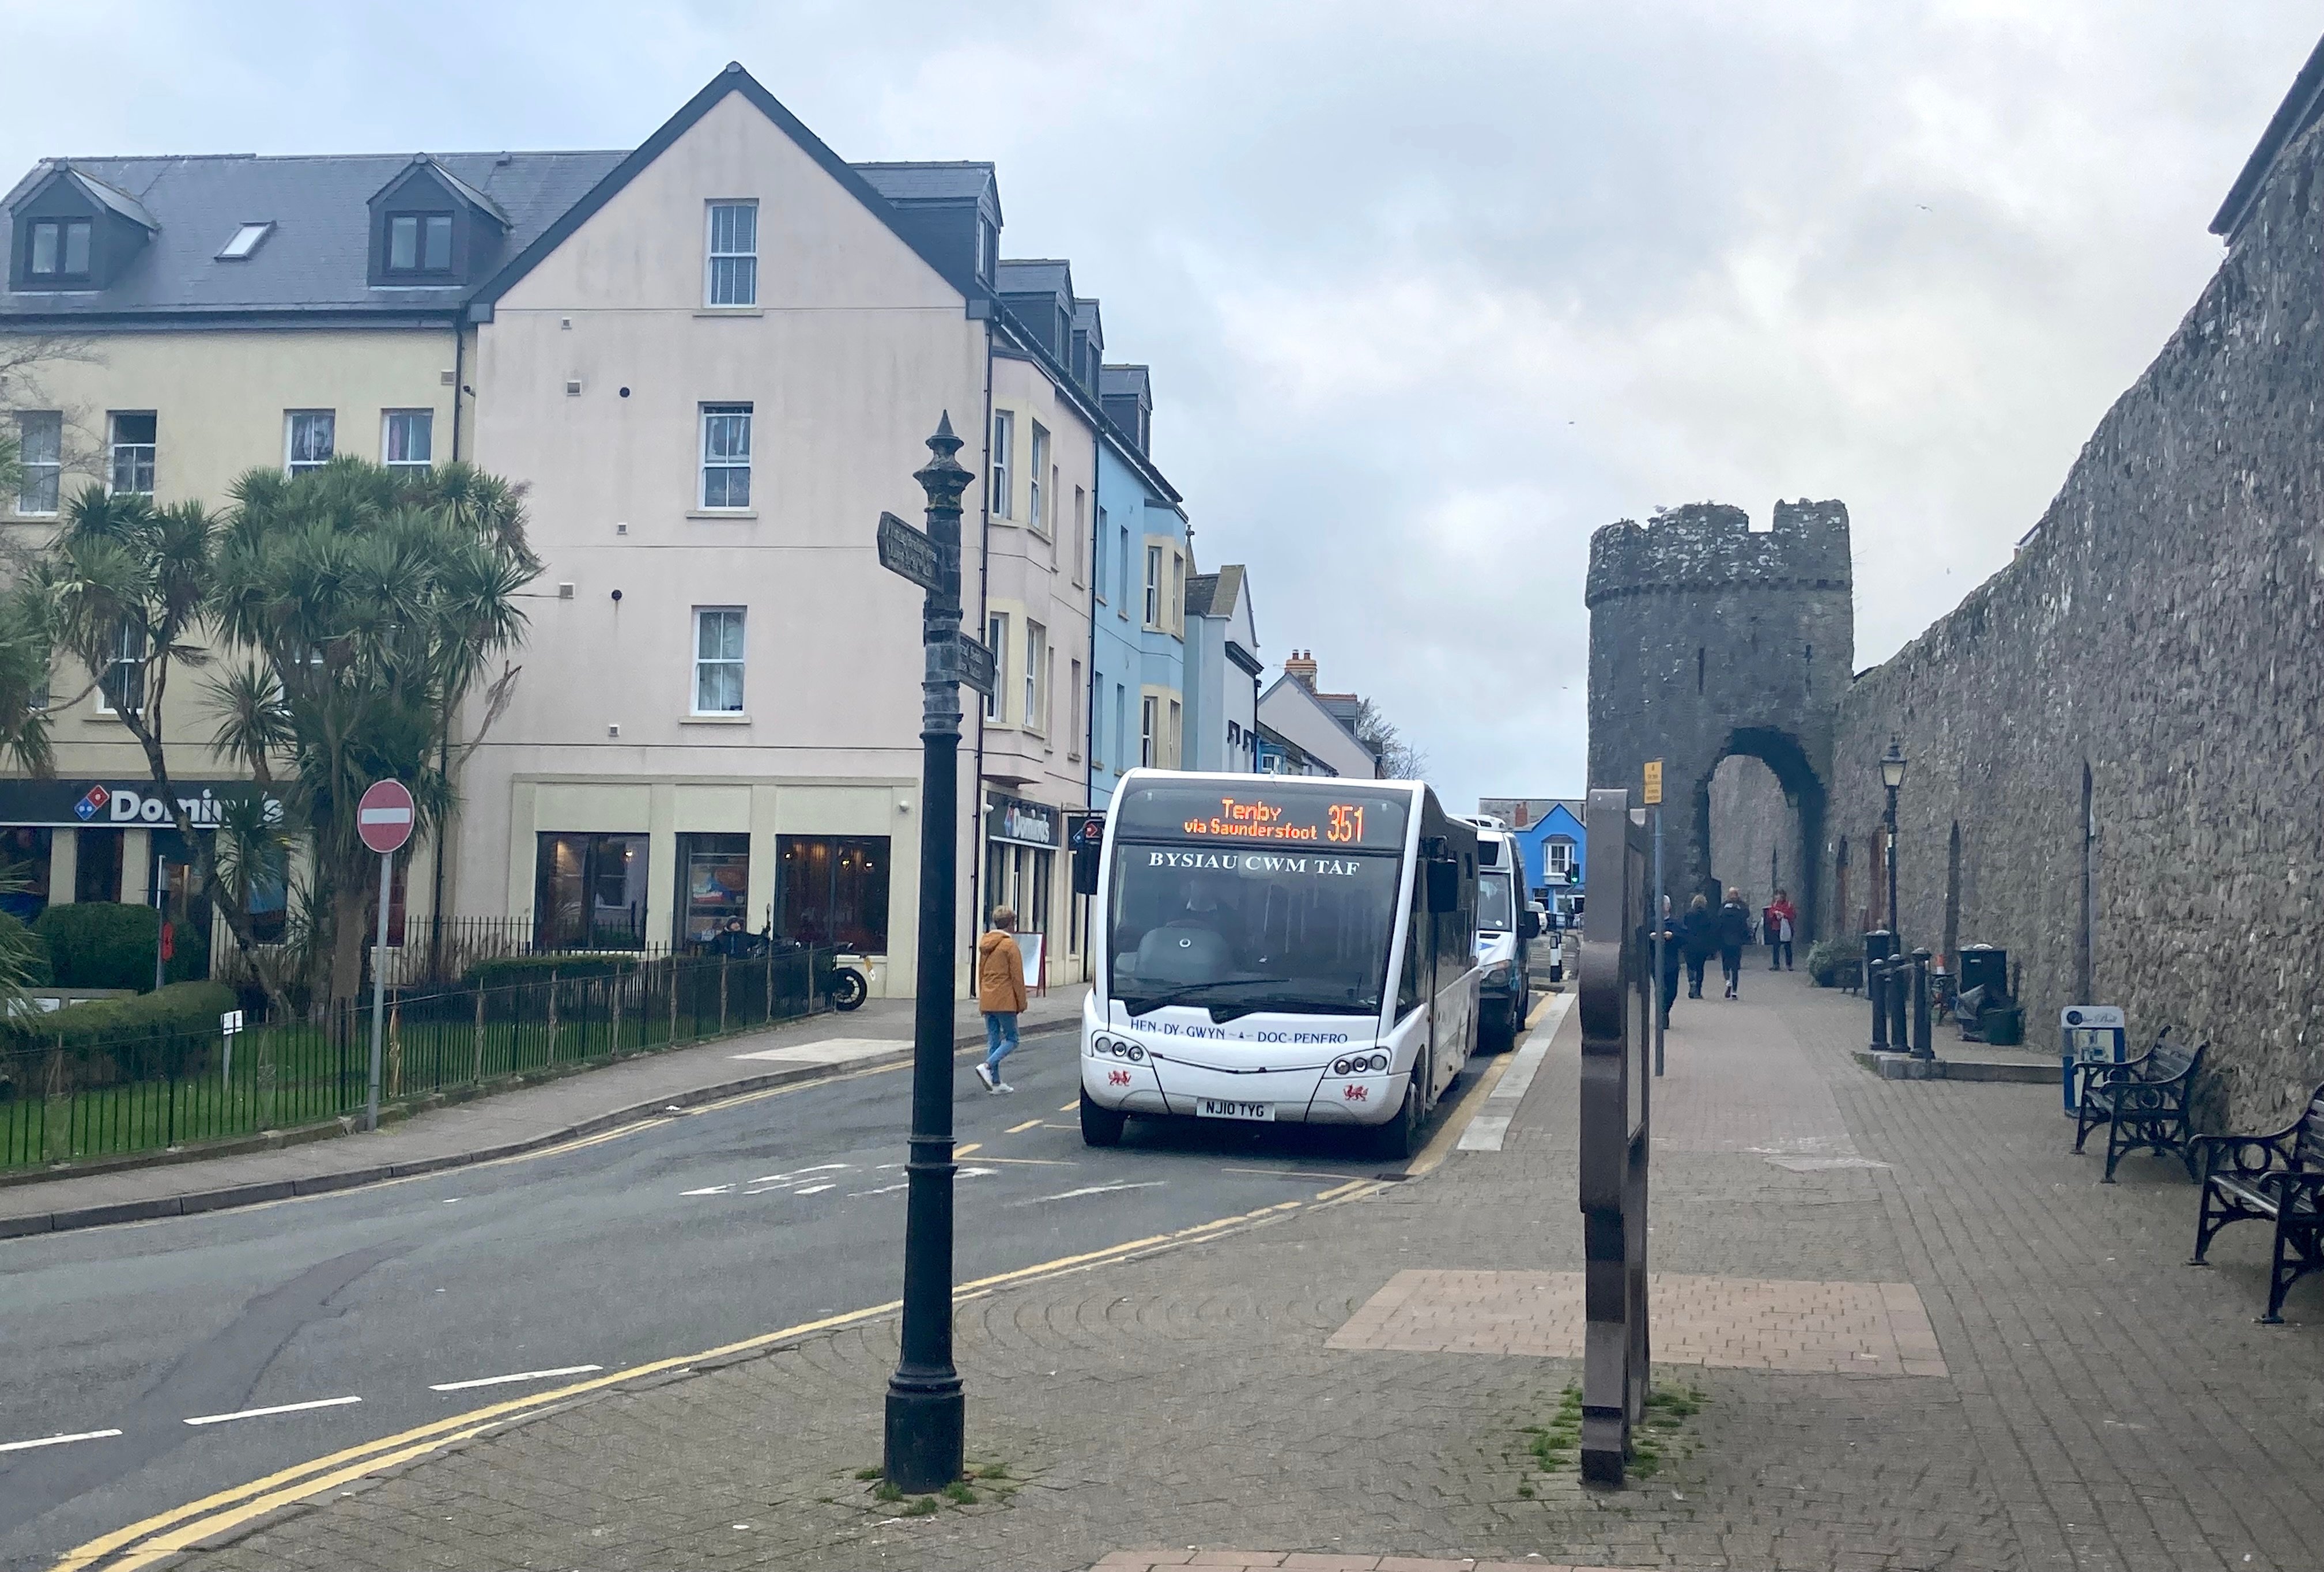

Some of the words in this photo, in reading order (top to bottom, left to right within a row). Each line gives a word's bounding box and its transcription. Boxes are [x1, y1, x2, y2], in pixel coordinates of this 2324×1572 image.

[111, 788, 284, 822] Domi's
[1221, 798, 1282, 822] Tenby
[1184, 818, 1207, 834] via
[1210, 817, 1318, 840] Saundersfoot
[1327, 804, 1364, 843] 351
[1148, 852, 1238, 870] BYSIAU
[1246, 856, 1307, 873] CWM
[1206, 1101, 1235, 1115] NJ10
[1240, 1103, 1264, 1117] TYG
